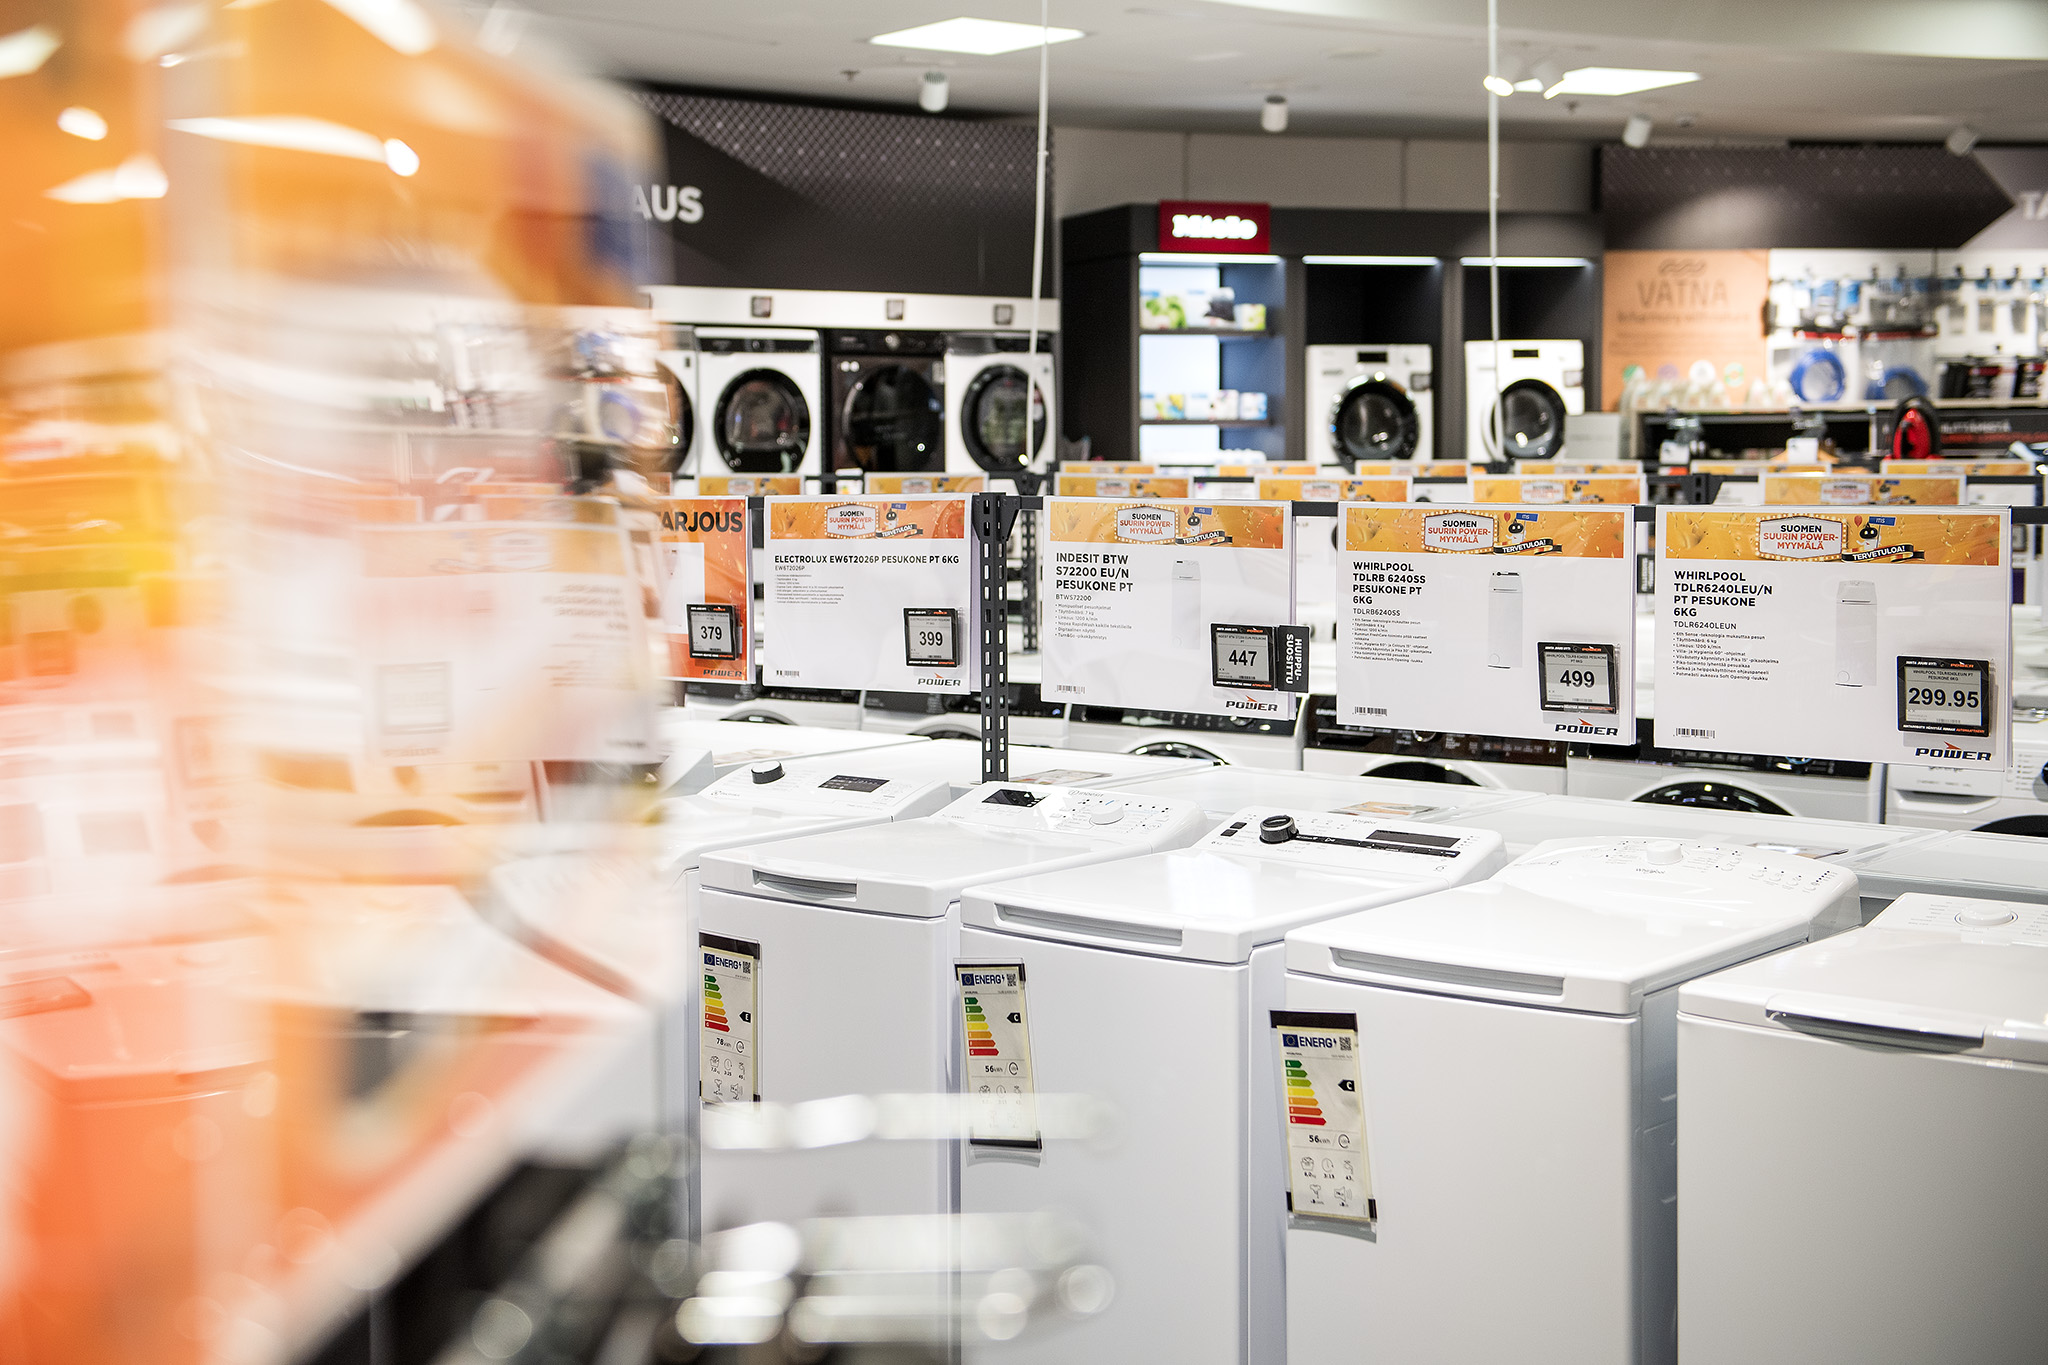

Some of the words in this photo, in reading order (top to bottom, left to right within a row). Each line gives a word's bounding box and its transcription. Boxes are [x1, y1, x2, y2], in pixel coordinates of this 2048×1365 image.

[1637, 279, 1728, 309] VATNA
[1442, 520, 1477, 528] SUOMEN
[1780, 525, 1822, 533] SUOMEN
[1182, 531, 1220, 544] TERVETULOA!
[1458, 528, 1491, 536] POWER-
[1800, 532, 1839, 543] POWER-
[1440, 535, 1478, 544] MYYMÄLÄ
[1502, 539, 1546, 554] TERVETULOA!
[1777, 541, 1825, 551] MYYMÄLÄ
[1056, 553, 1100, 564] INDESIT
[1102, 554, 1128, 565] BTW
[1852, 545, 1906, 562] TERVETULOA!
[775, 555, 827, 564] ELECTROLUX
[829, 555, 879, 564] EW6T2026P
[882, 555, 927, 564] PESUKONE
[929, 556, 940, 564] PT
[942, 556, 959, 564] 6KG
[1056, 566, 1097, 577] S72200
[1100, 568, 1129, 579] EU/N
[1353, 562, 1414, 572] WHIRLPOOL
[1353, 573, 1385, 582] TDLRB
[1388, 575, 1426, 584] 6240SS
[1674, 571, 1746, 582] WHIRLPOOL
[1056, 580, 1116, 591] PESUKONE
[1120, 582, 1133, 592] PT
[1353, 585, 1406, 594] PESUKONE
[1409, 587, 1422, 595] PT
[1674, 583, 1773, 596] TDLR6240LEU/N
[1353, 596, 1372, 604] 6KG
[1674, 596, 1688, 604] PT
[1691, 596, 1756, 606] PESUKONE
[1353, 608, 1400, 616] TDLRB6240SS
[1674, 608, 1697, 617] 6KG
[1674, 621, 1737, 630] TDLR6240LEUN
[700, 626, 722, 640] 379
[919, 632, 943, 646] 399
[1229, 649, 1257, 667] 447
[1286, 634, 1294, 684] SUOSITTU
[1294, 638, 1302, 681] HUIPPU-
[918, 678, 961, 686] POWER
[1560, 670, 1595, 688] 499
[1908, 687, 1979, 708] 299.95
[1226, 701, 1278, 712] POWER
[1555, 724, 1618, 736] POWER
[1915, 747, 1992, 761] POWER
[1346, 1081, 1352, 1090] C
